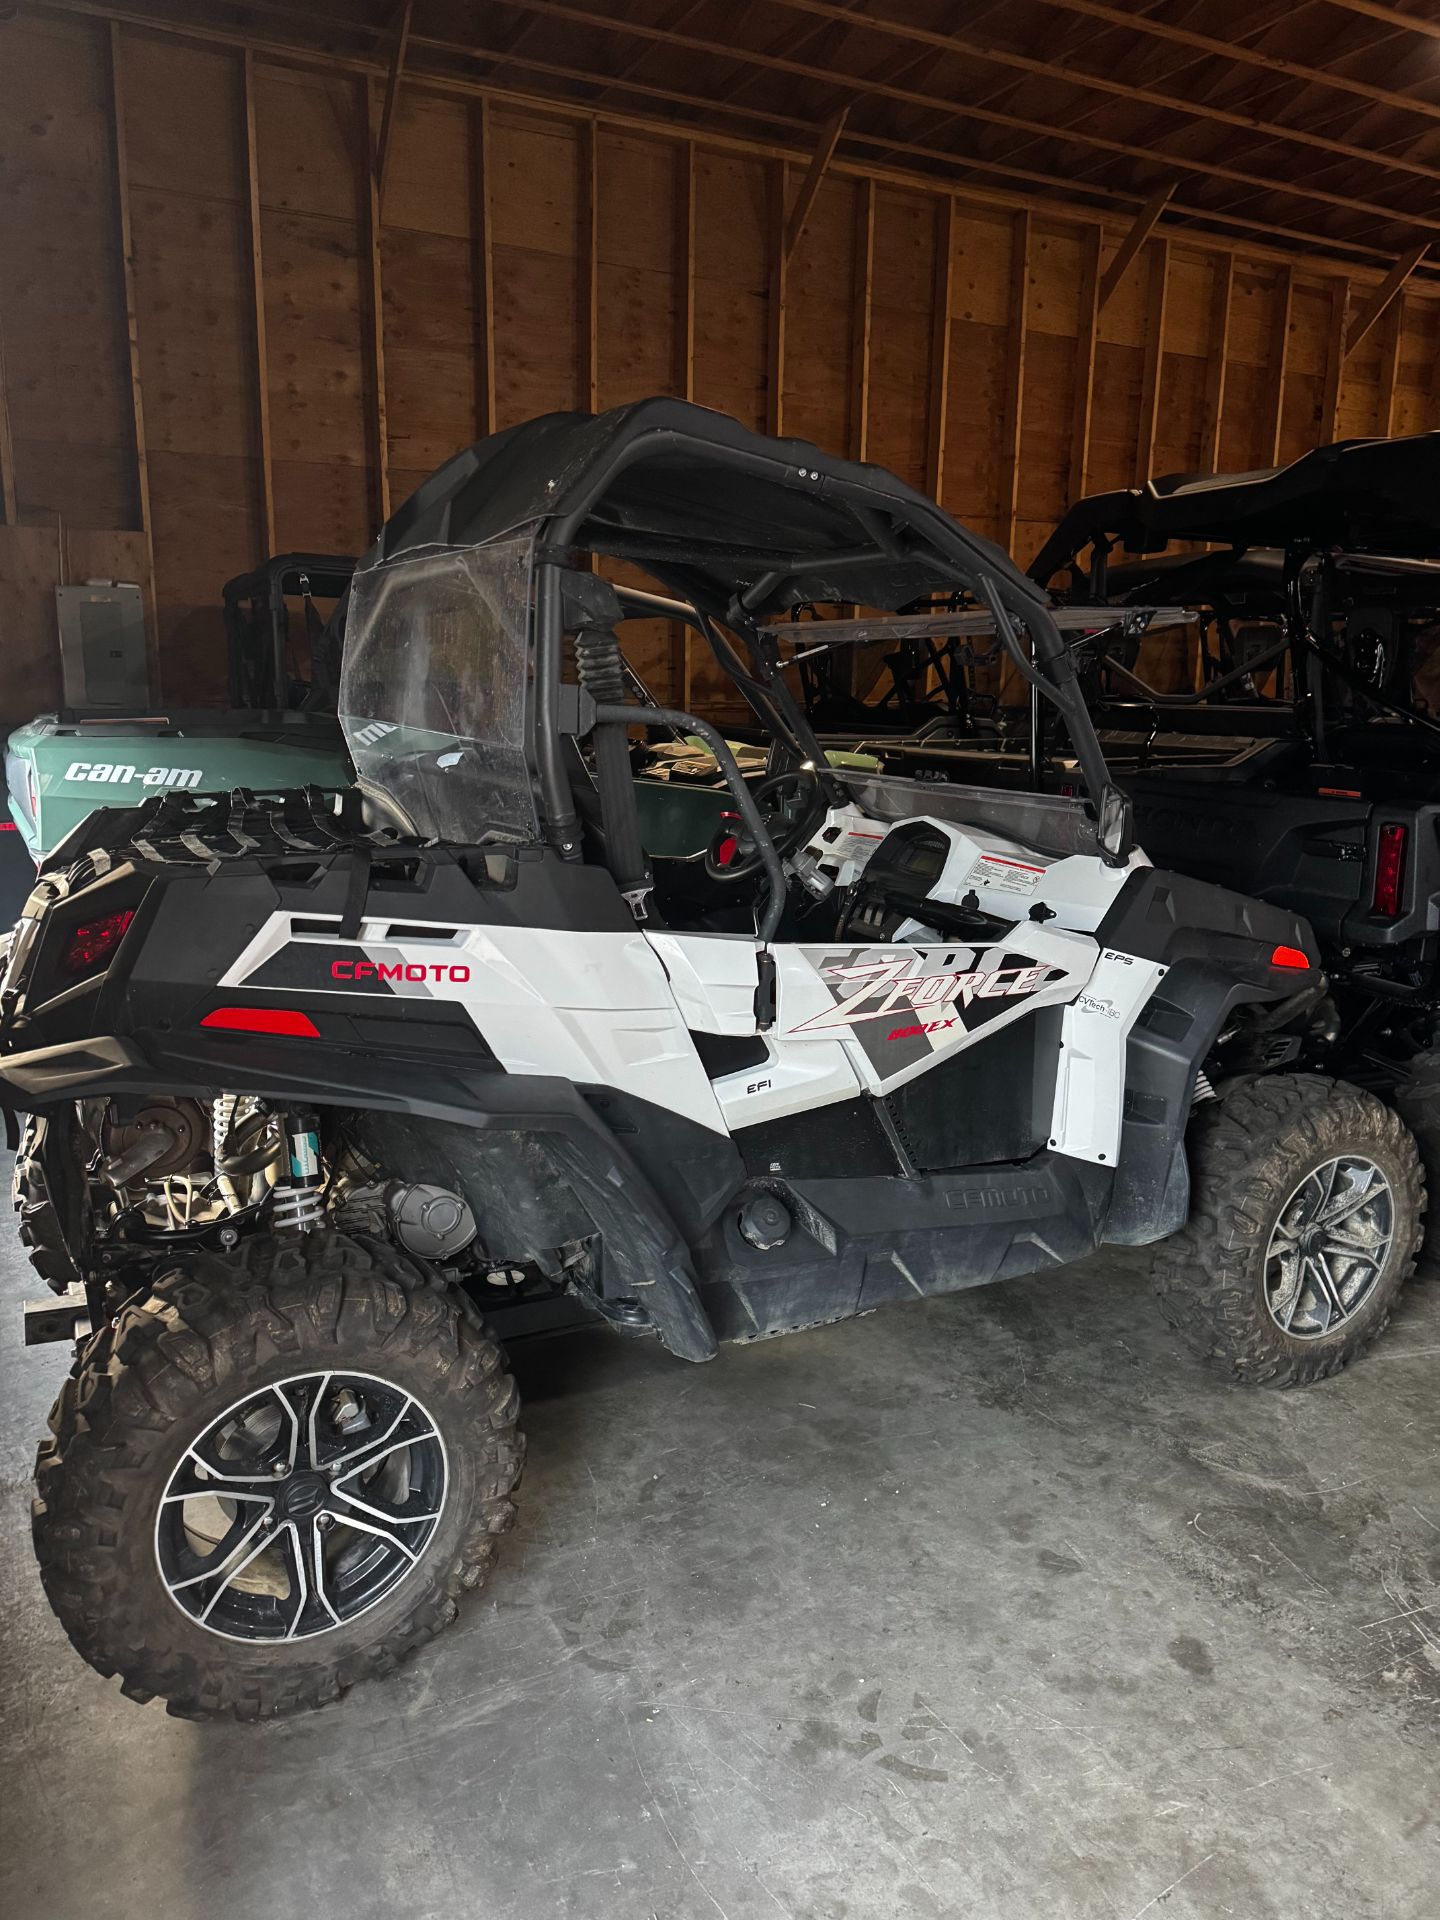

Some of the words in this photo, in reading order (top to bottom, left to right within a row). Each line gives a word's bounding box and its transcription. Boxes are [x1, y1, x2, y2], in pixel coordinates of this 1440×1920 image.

[64, 762, 203, 787] can-am
[1104, 952, 1134, 966] EPS
[331, 960, 471, 982] CFMOTO
[747, 1079, 772, 1094] EFI
[943, 1187, 1050, 1209] CFMOTO
